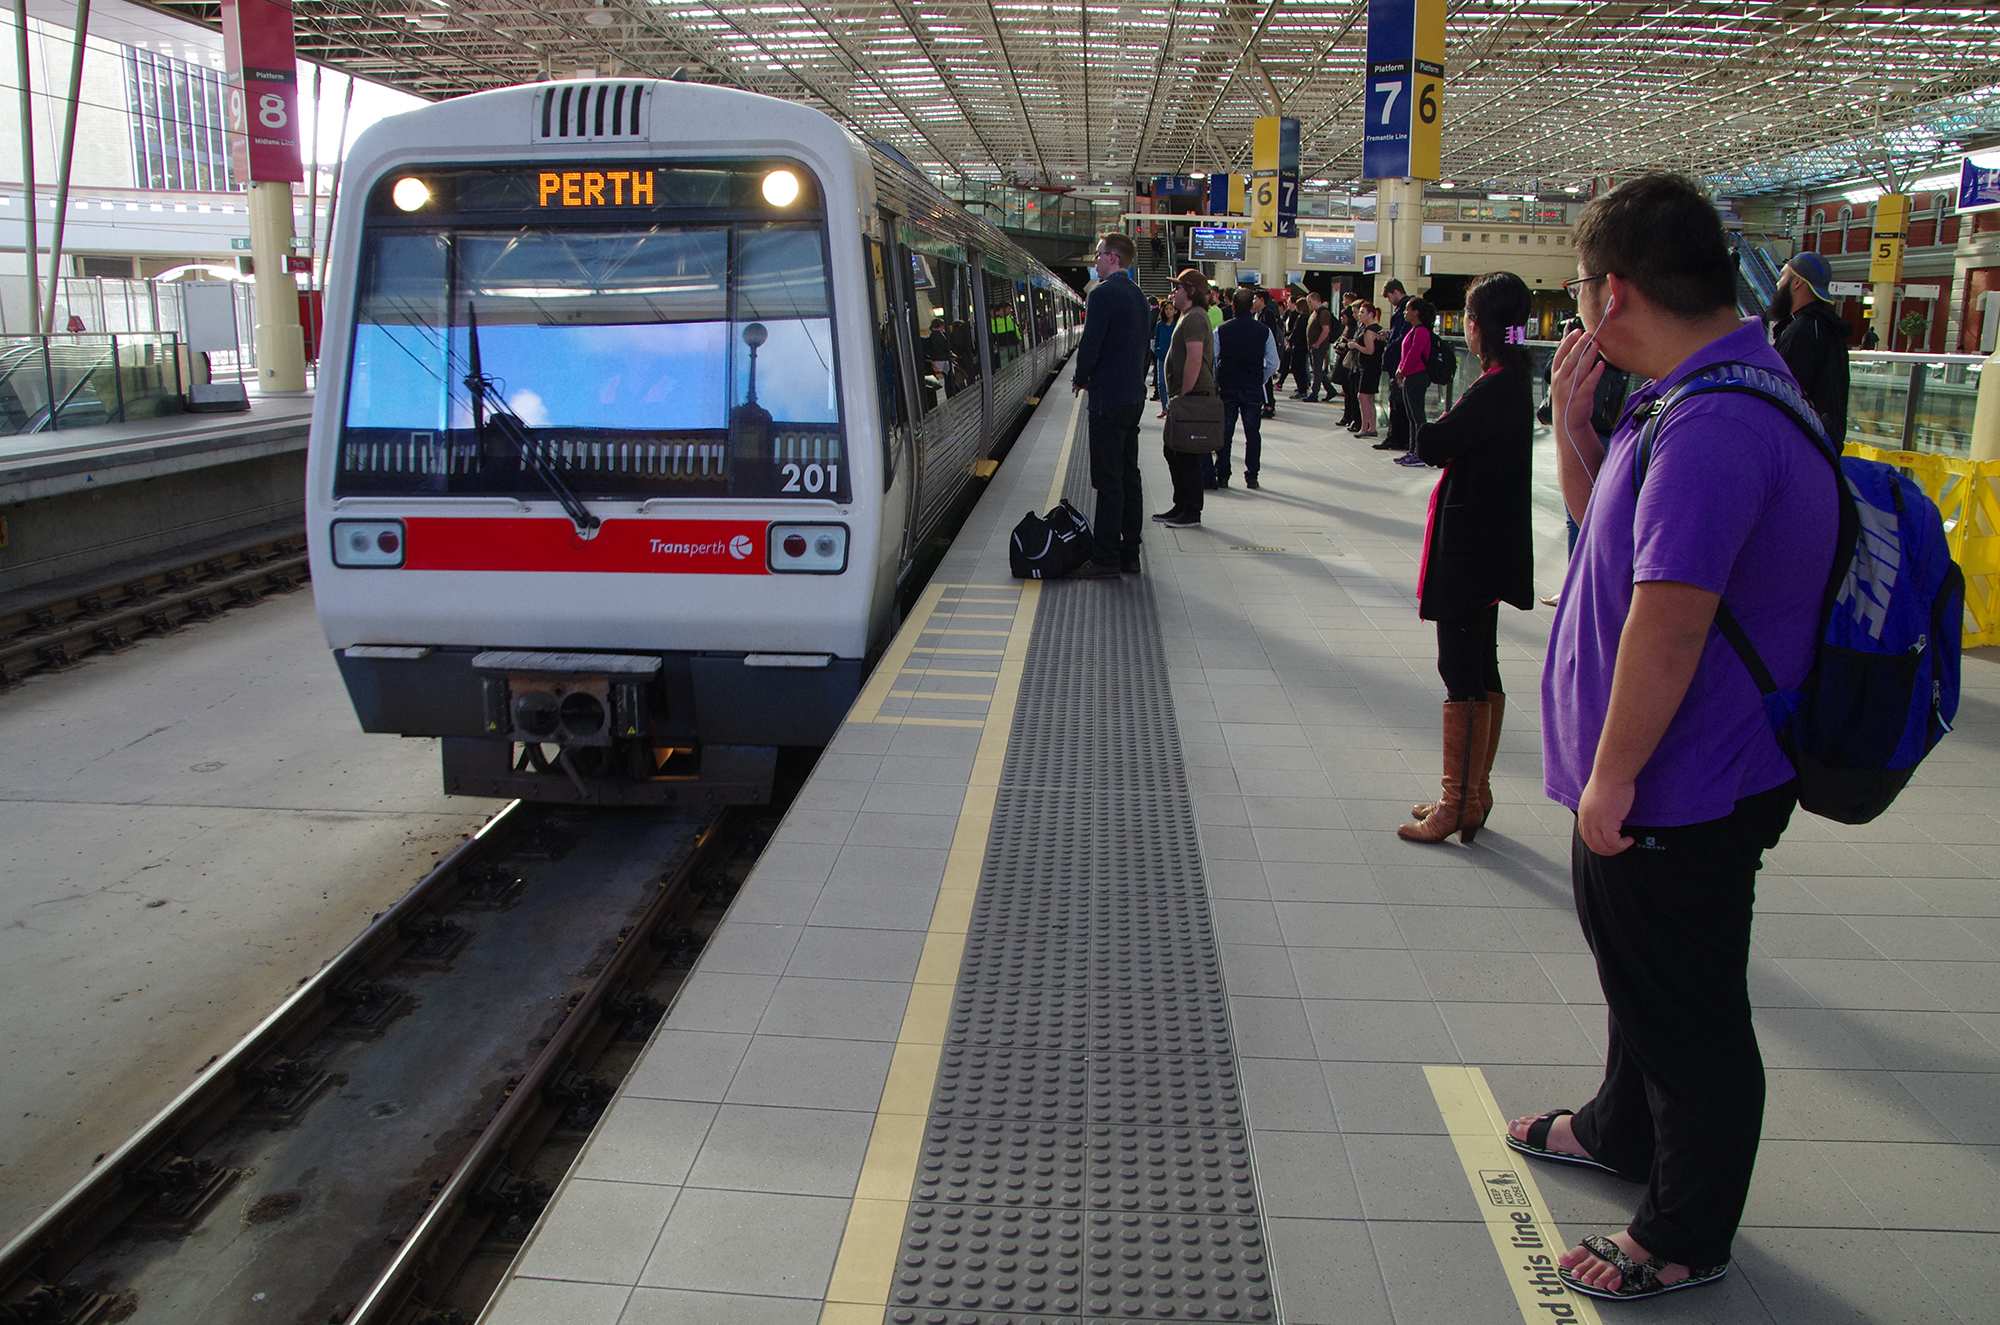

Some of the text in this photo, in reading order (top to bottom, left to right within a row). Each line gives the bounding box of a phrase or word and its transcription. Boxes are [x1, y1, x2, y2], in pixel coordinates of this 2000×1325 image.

[255, 71, 285, 80] Platform
[1374, 63, 1404, 73] Platform
[259, 93, 288, 129] 8
[1375, 80, 1403, 125] 7
[1418, 83, 1437, 124] 6
[1366, 134, 1394, 142] Fremantle
[539, 171, 654, 207] PERTH
[1257, 181, 1272, 206] 6
[1282, 182, 1295, 207] 7
[1879, 243, 1891, 258] 5
[781, 463, 838, 493] 201
[649, 538, 726, 558] Transperth
[1490, 1188, 1504, 1204] KEEP
[1501, 1189, 1515, 1205] KIDS
[1511, 1185, 1526, 1205] CLOSE
[1510, 1211, 1544, 1249] line
[1522, 1254, 1565, 1297] this
